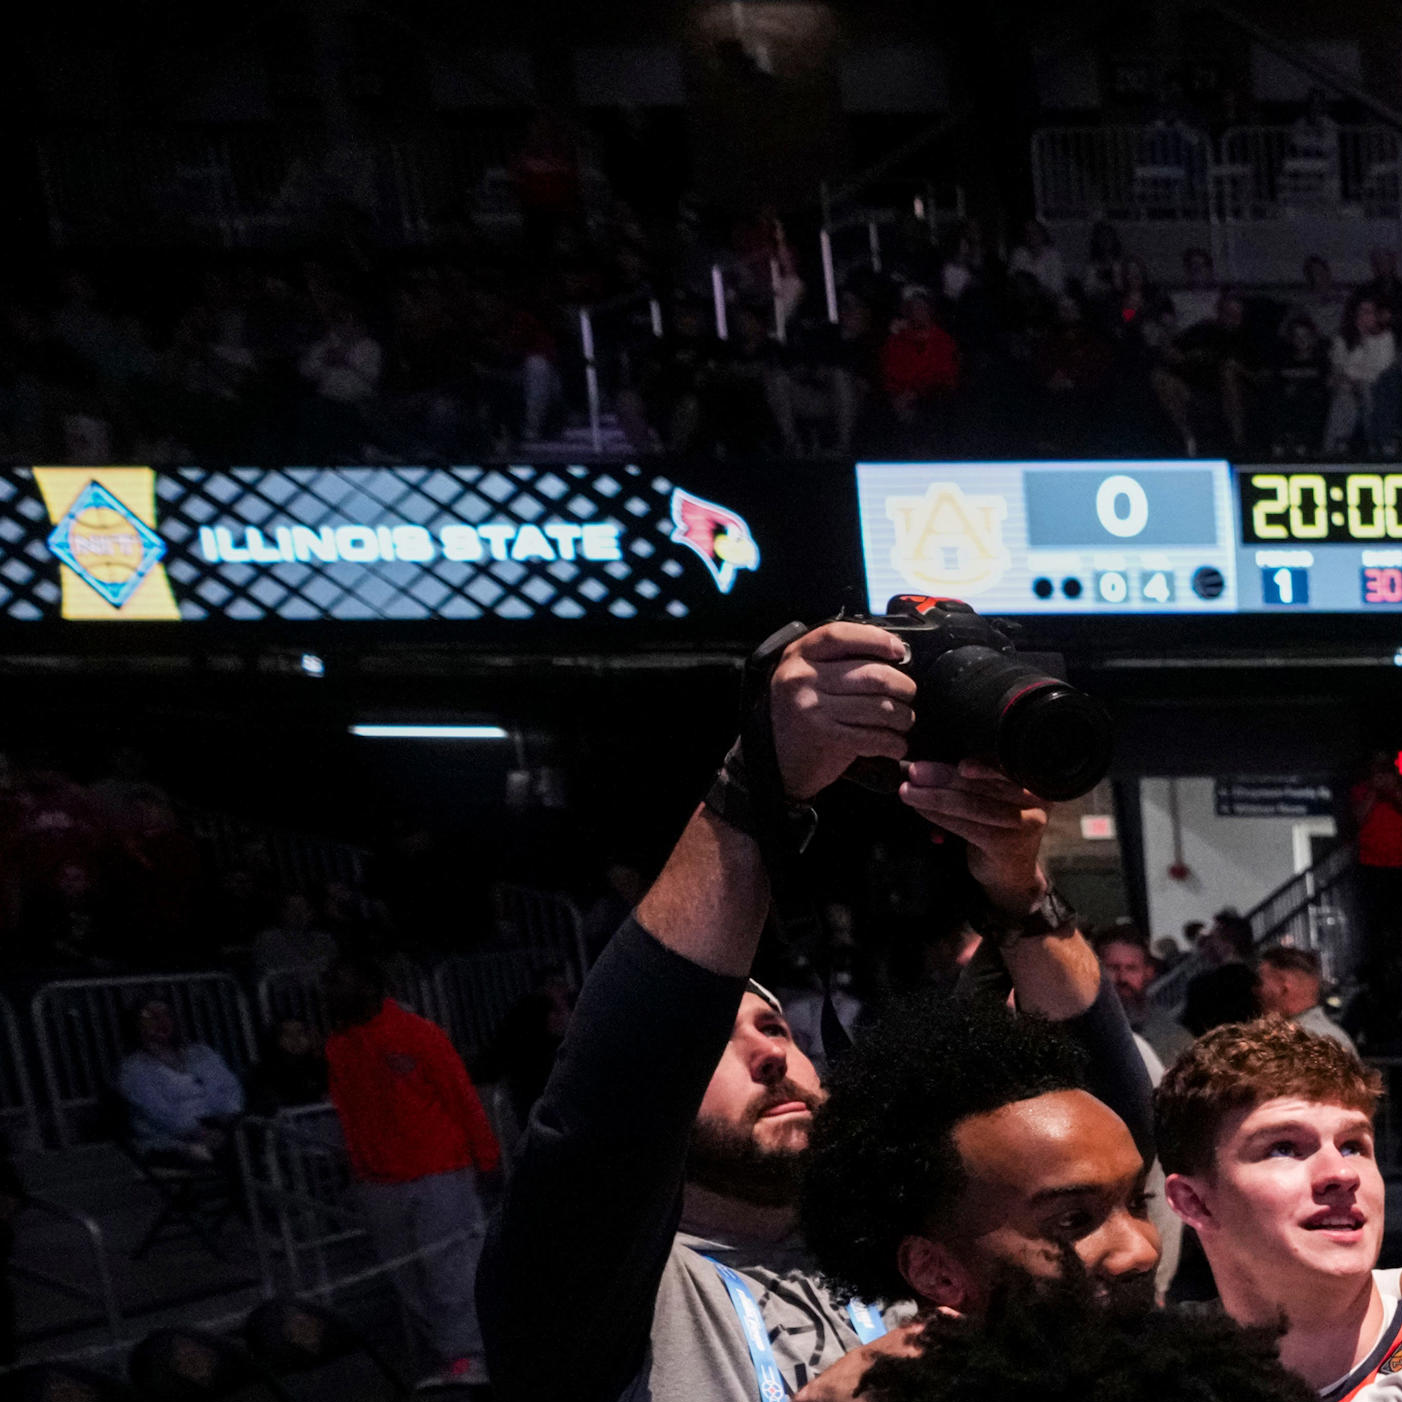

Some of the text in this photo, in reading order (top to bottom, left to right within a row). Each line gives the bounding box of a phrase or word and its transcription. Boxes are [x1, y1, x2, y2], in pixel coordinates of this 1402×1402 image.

[1096, 475, 1149, 538] 0
[200, 525, 623, 564] ILLINOIS STATE
[1100, 571, 1171, 603] 0 4
[1273, 568, 1294, 604] 1
